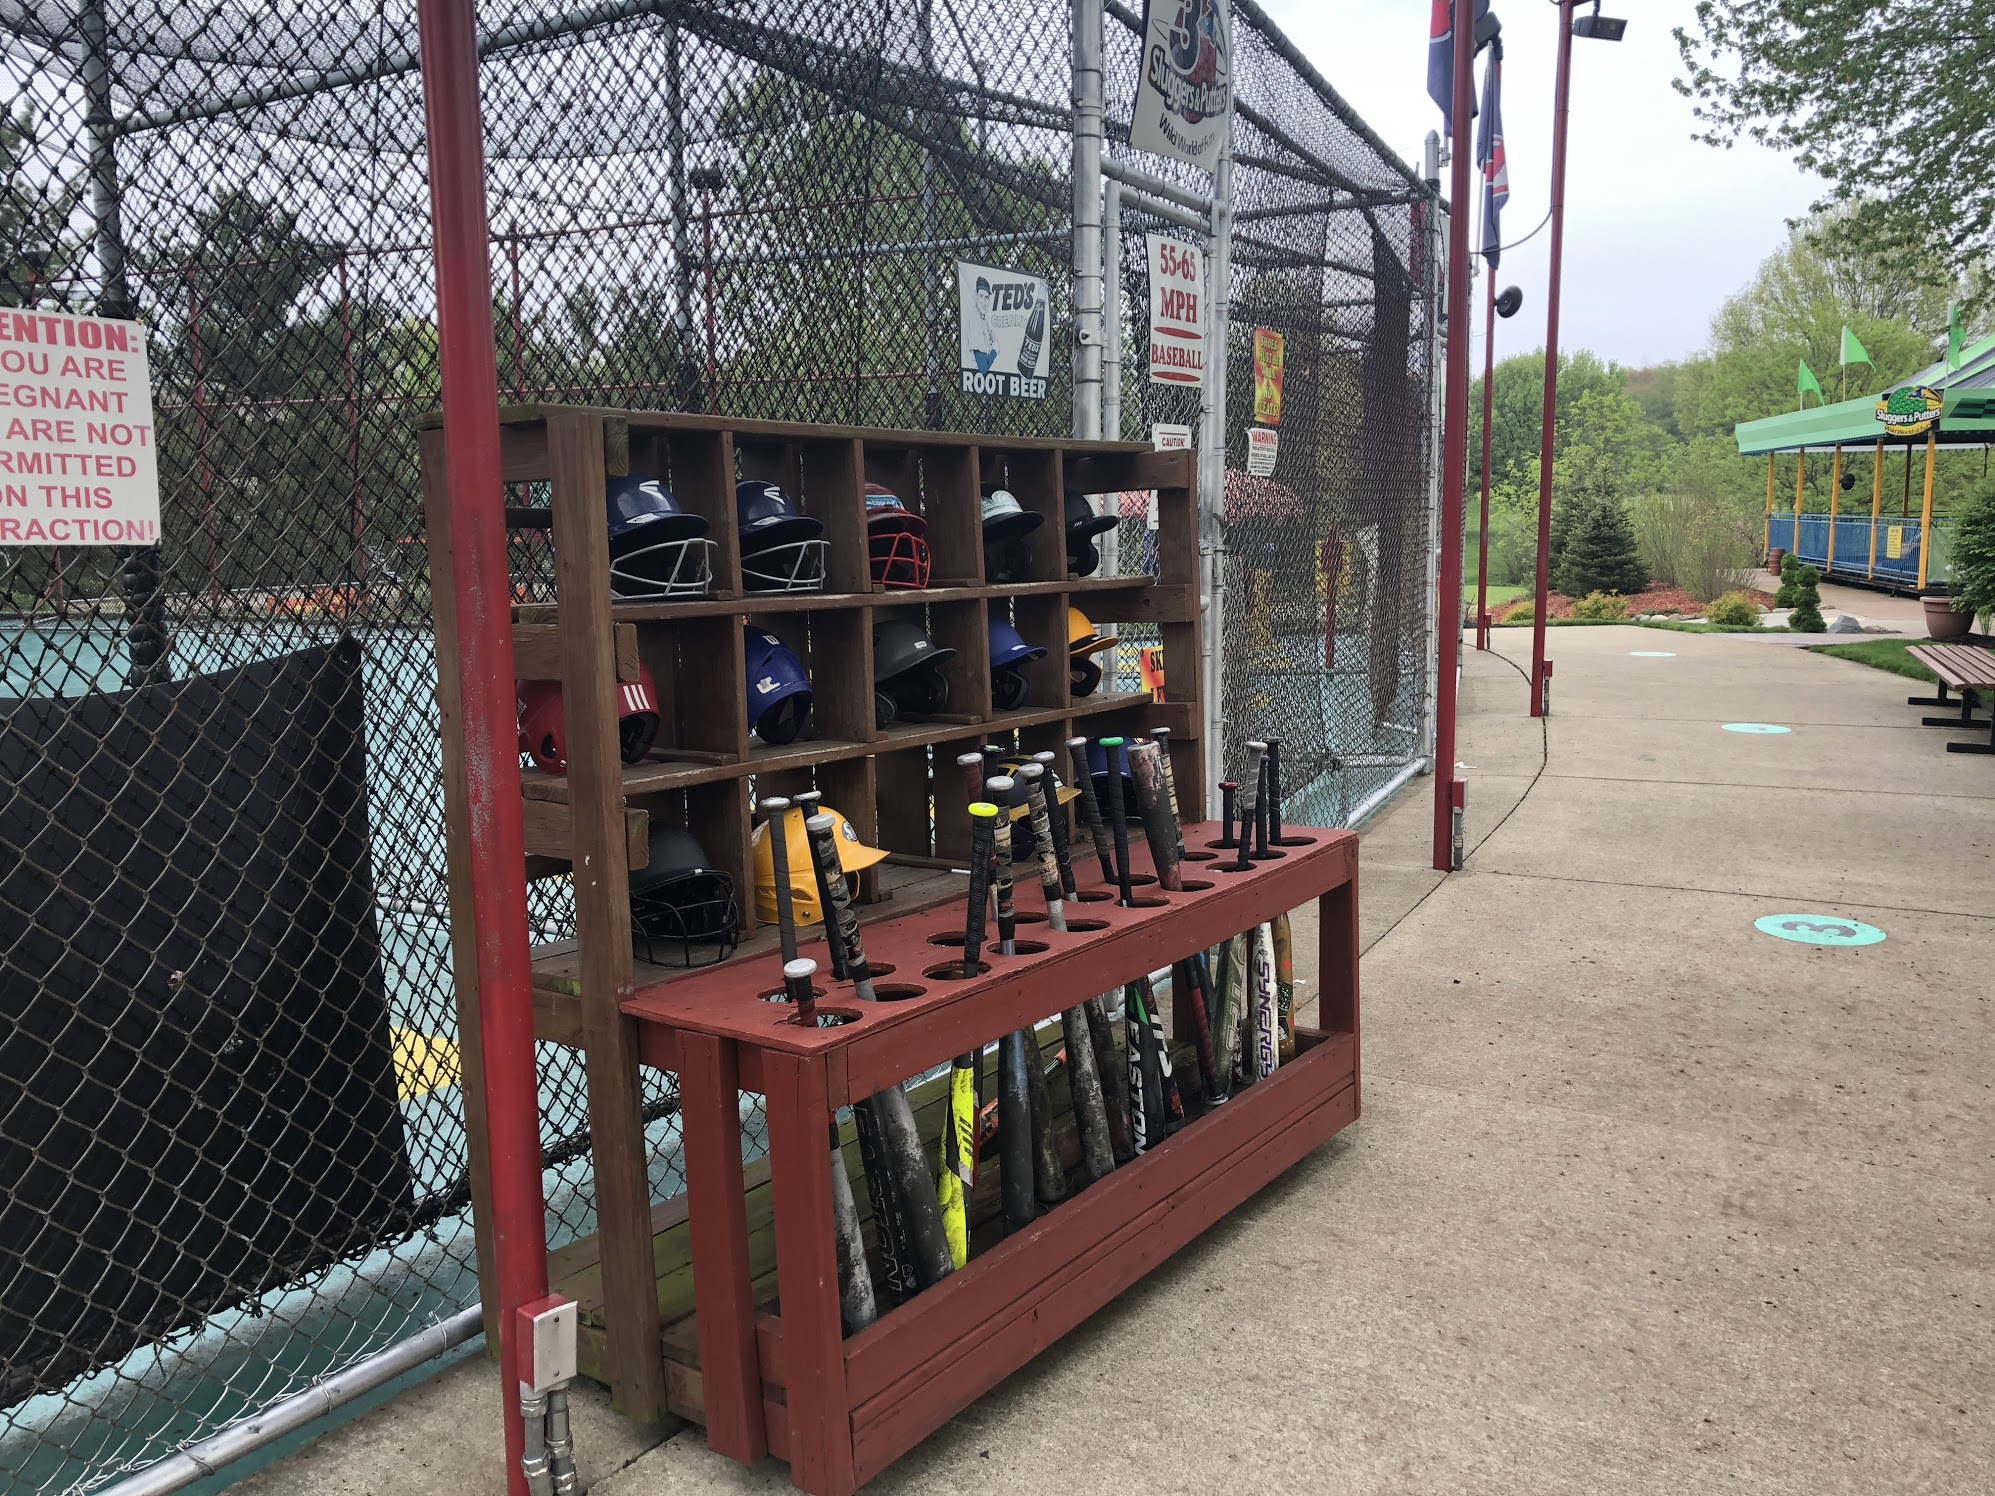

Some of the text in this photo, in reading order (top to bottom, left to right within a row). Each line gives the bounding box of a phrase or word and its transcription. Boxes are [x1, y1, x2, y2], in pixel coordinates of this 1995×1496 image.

[1150, 46, 1195, 111] Sluggers
[1159, 112, 1177, 146] Wild
[1160, 242, 1197, 283] 55-65
[991, 282, 1036, 312] TED'S
[1160, 287, 1198, 323] MPH
[0, 312, 139, 353] ENTION:
[0, 349, 127, 382] OU ARE
[1151, 343, 1203, 371] BASEBALL
[962, 371, 1047, 399] ROOT BEER
[1263, 385, 1273, 400] NO
[1876, 409, 1908, 425] Sluggers
[1914, 408, 1941, 422] Putters
[6, 417, 150, 447] ARE NOT
[1251, 431, 1277, 446] WARNING
[0, 450, 136, 478] RMITTED
[0, 484, 113, 509] N THIS
[0, 518, 154, 541] RACTION!
[1781, 920, 1857, 938] 3
[1126, 1018, 1149, 1156] EASTON
